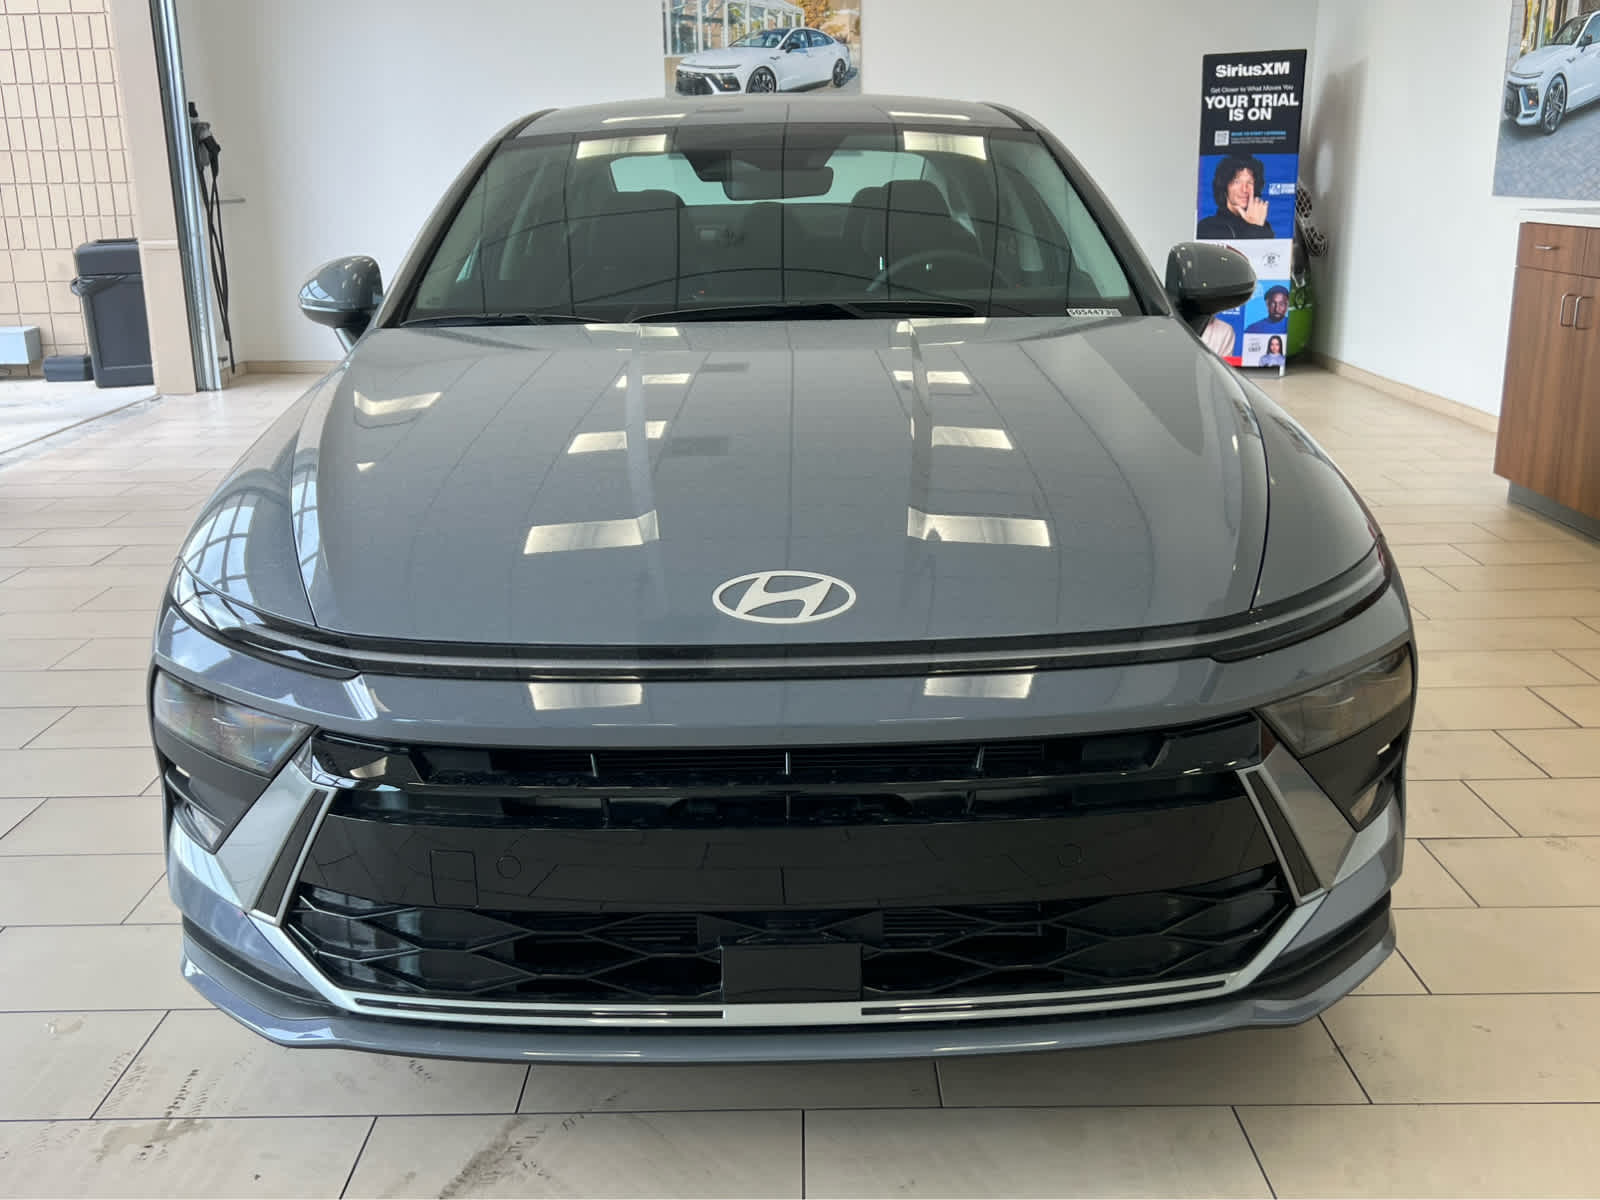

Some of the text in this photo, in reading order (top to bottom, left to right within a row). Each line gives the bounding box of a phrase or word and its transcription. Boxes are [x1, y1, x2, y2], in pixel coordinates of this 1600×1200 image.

[1215, 61, 1290, 77] SiriusXM
[1282, 83, 1294, 91] You
[1204, 92, 1299, 110] YOUR TRIAL
[1228, 107, 1272, 122] IS ON
